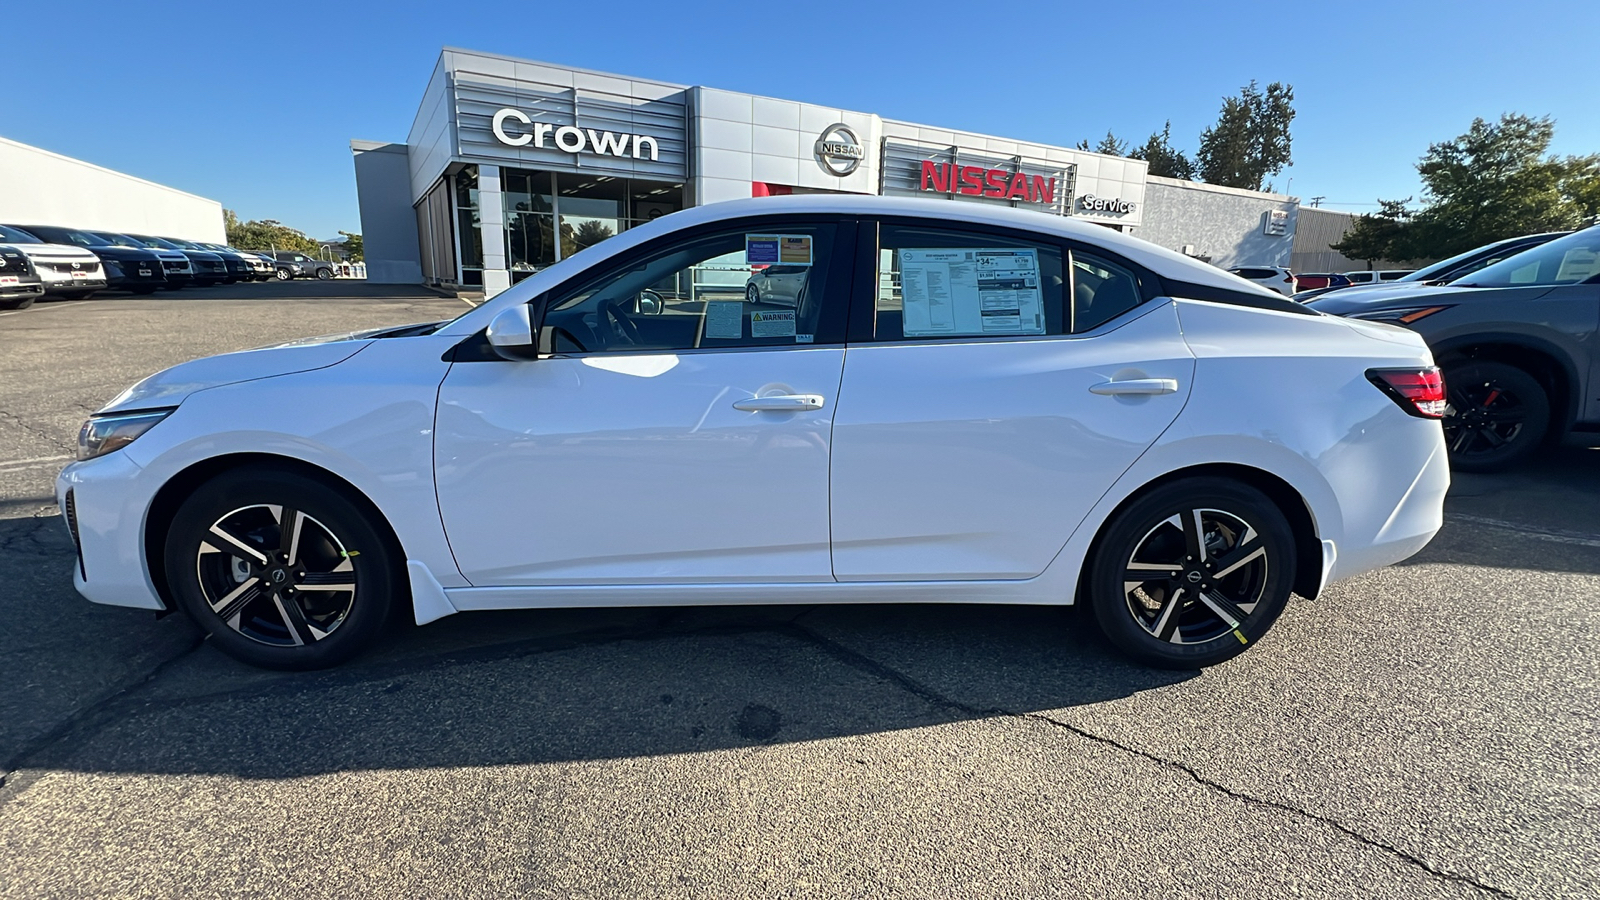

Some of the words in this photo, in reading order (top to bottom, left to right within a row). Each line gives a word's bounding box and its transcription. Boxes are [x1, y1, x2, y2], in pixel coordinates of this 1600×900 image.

[492, 108, 659, 161] Crown
[822, 143, 862, 156] NISSAN
[921, 160, 1056, 203] NISSAN
[1082, 194, 1136, 213] Service
